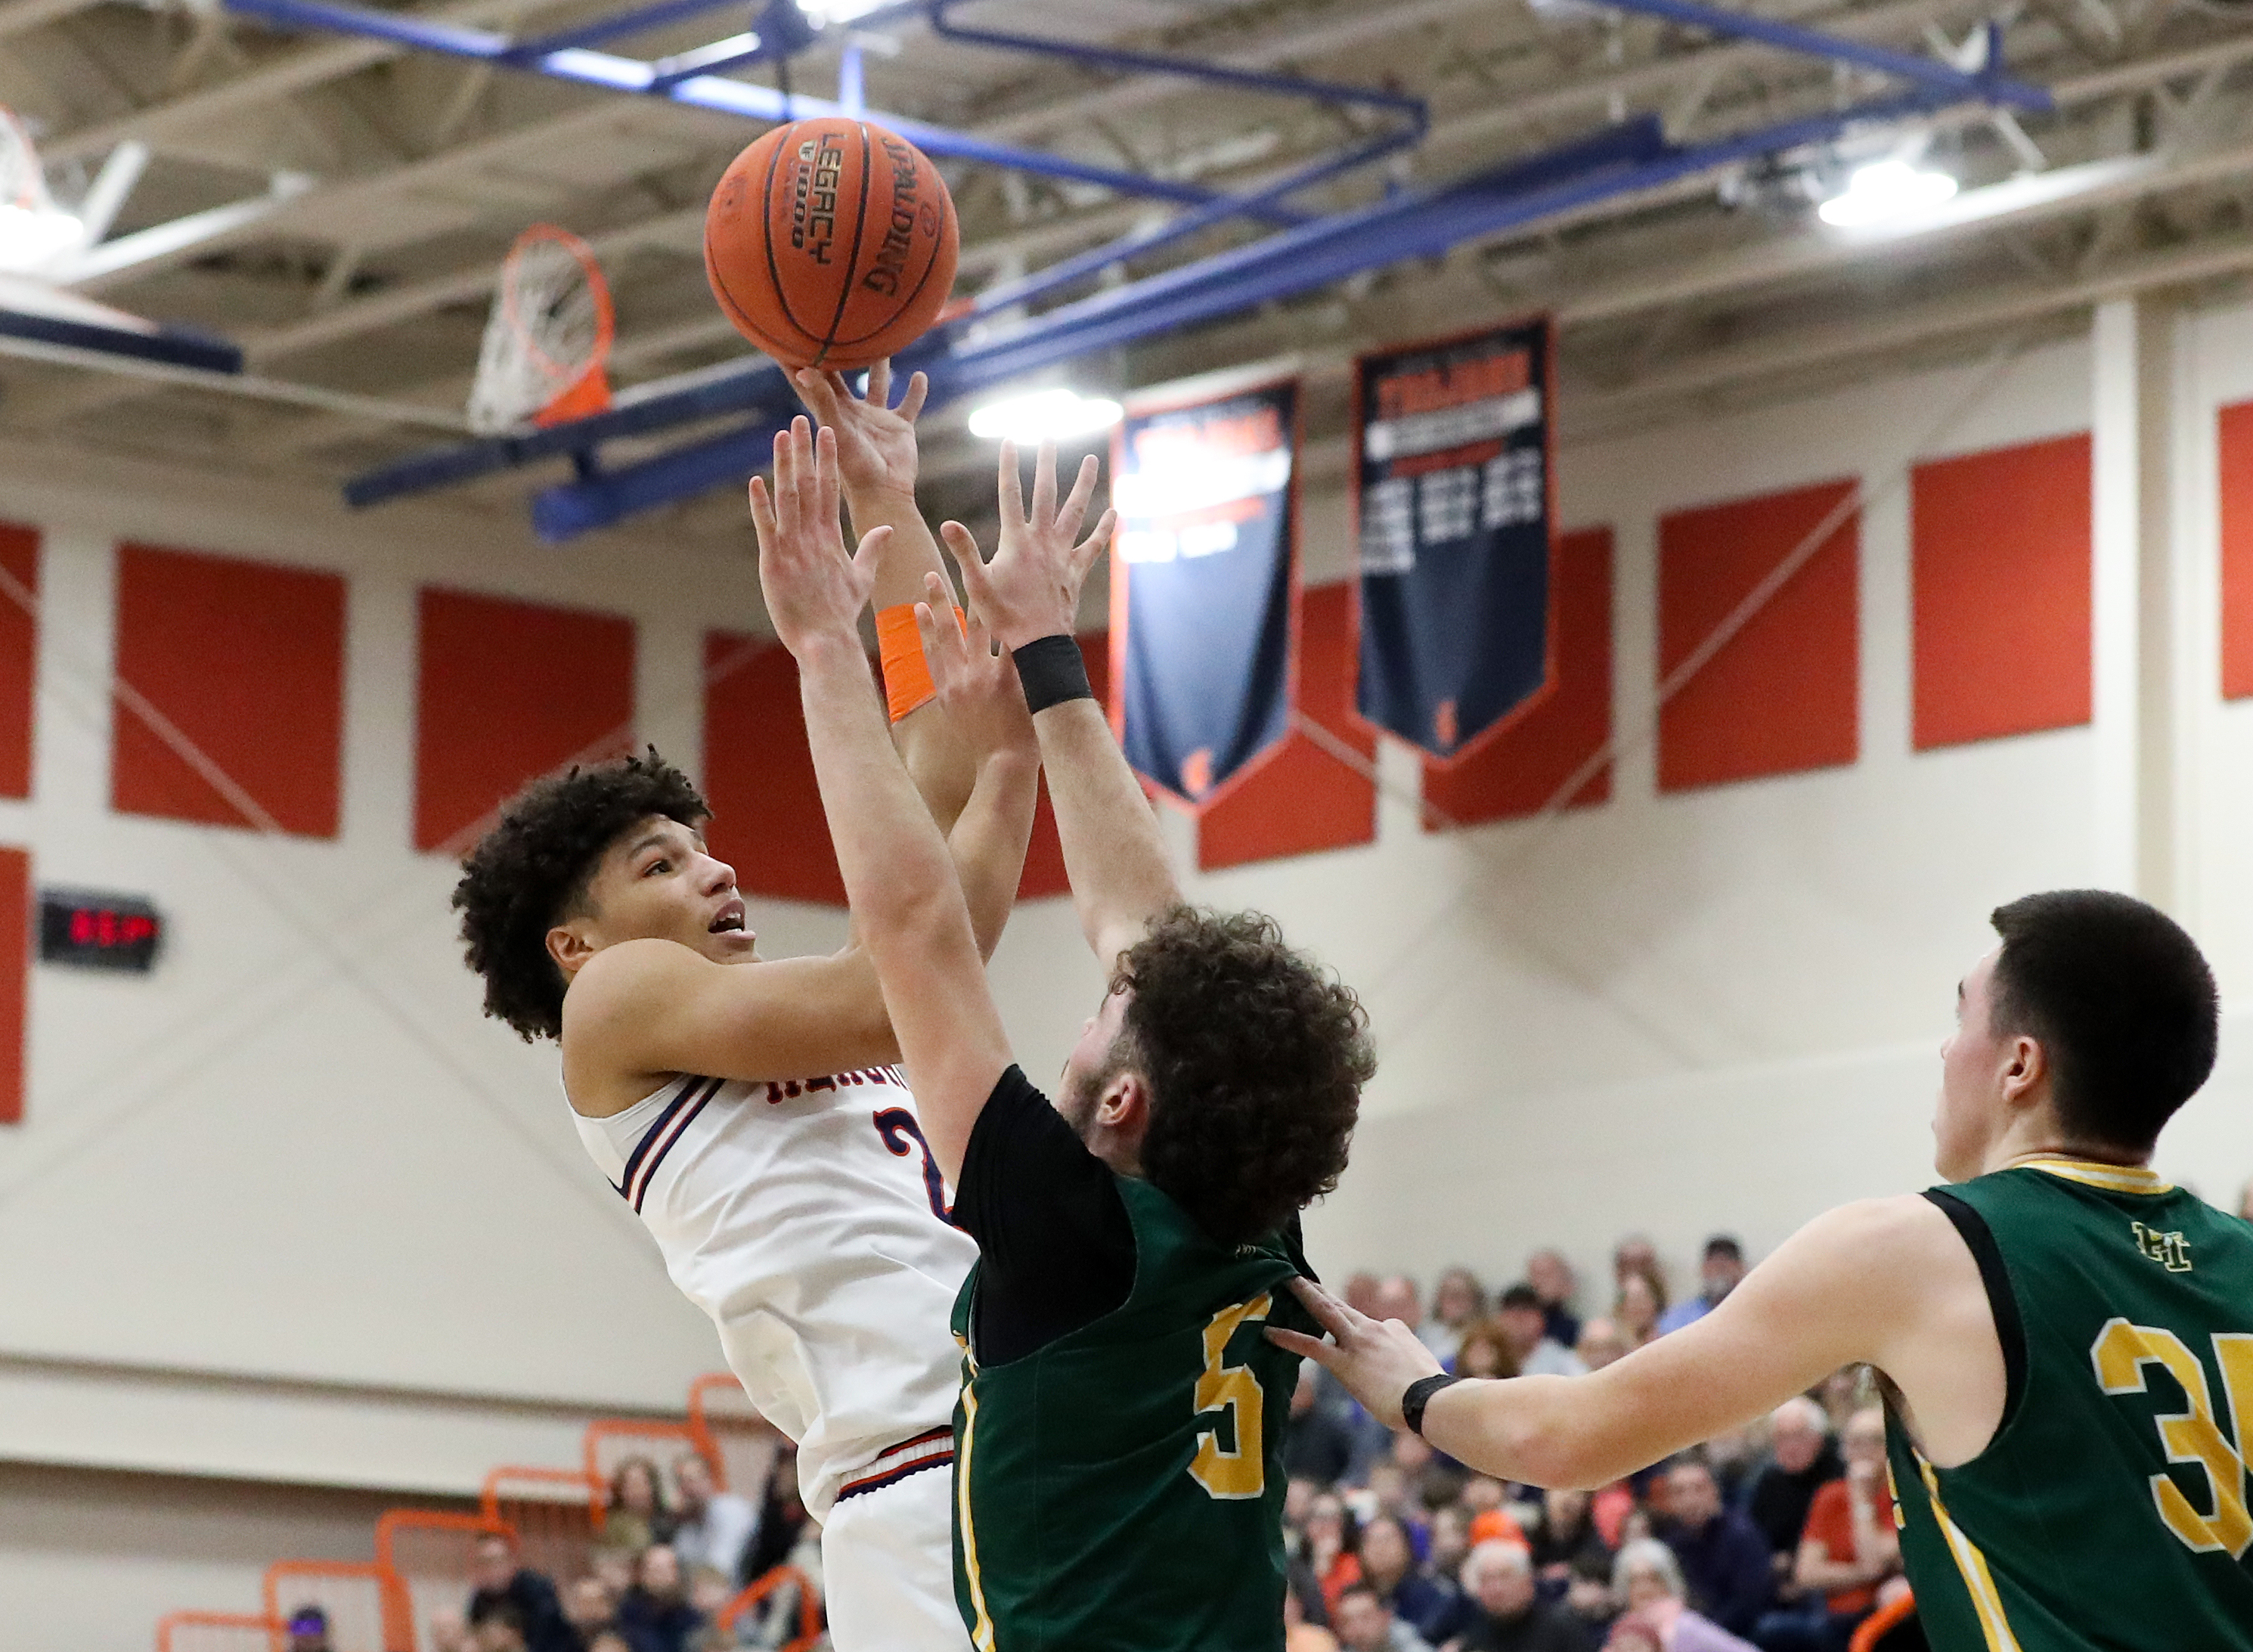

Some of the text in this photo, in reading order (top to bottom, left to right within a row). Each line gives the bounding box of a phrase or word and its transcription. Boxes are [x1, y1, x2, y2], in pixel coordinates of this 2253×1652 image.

[807, 132, 848, 265] LEGACY
[861, 135, 917, 298] SPALDING
[1186, 1291, 1274, 1500] 5
